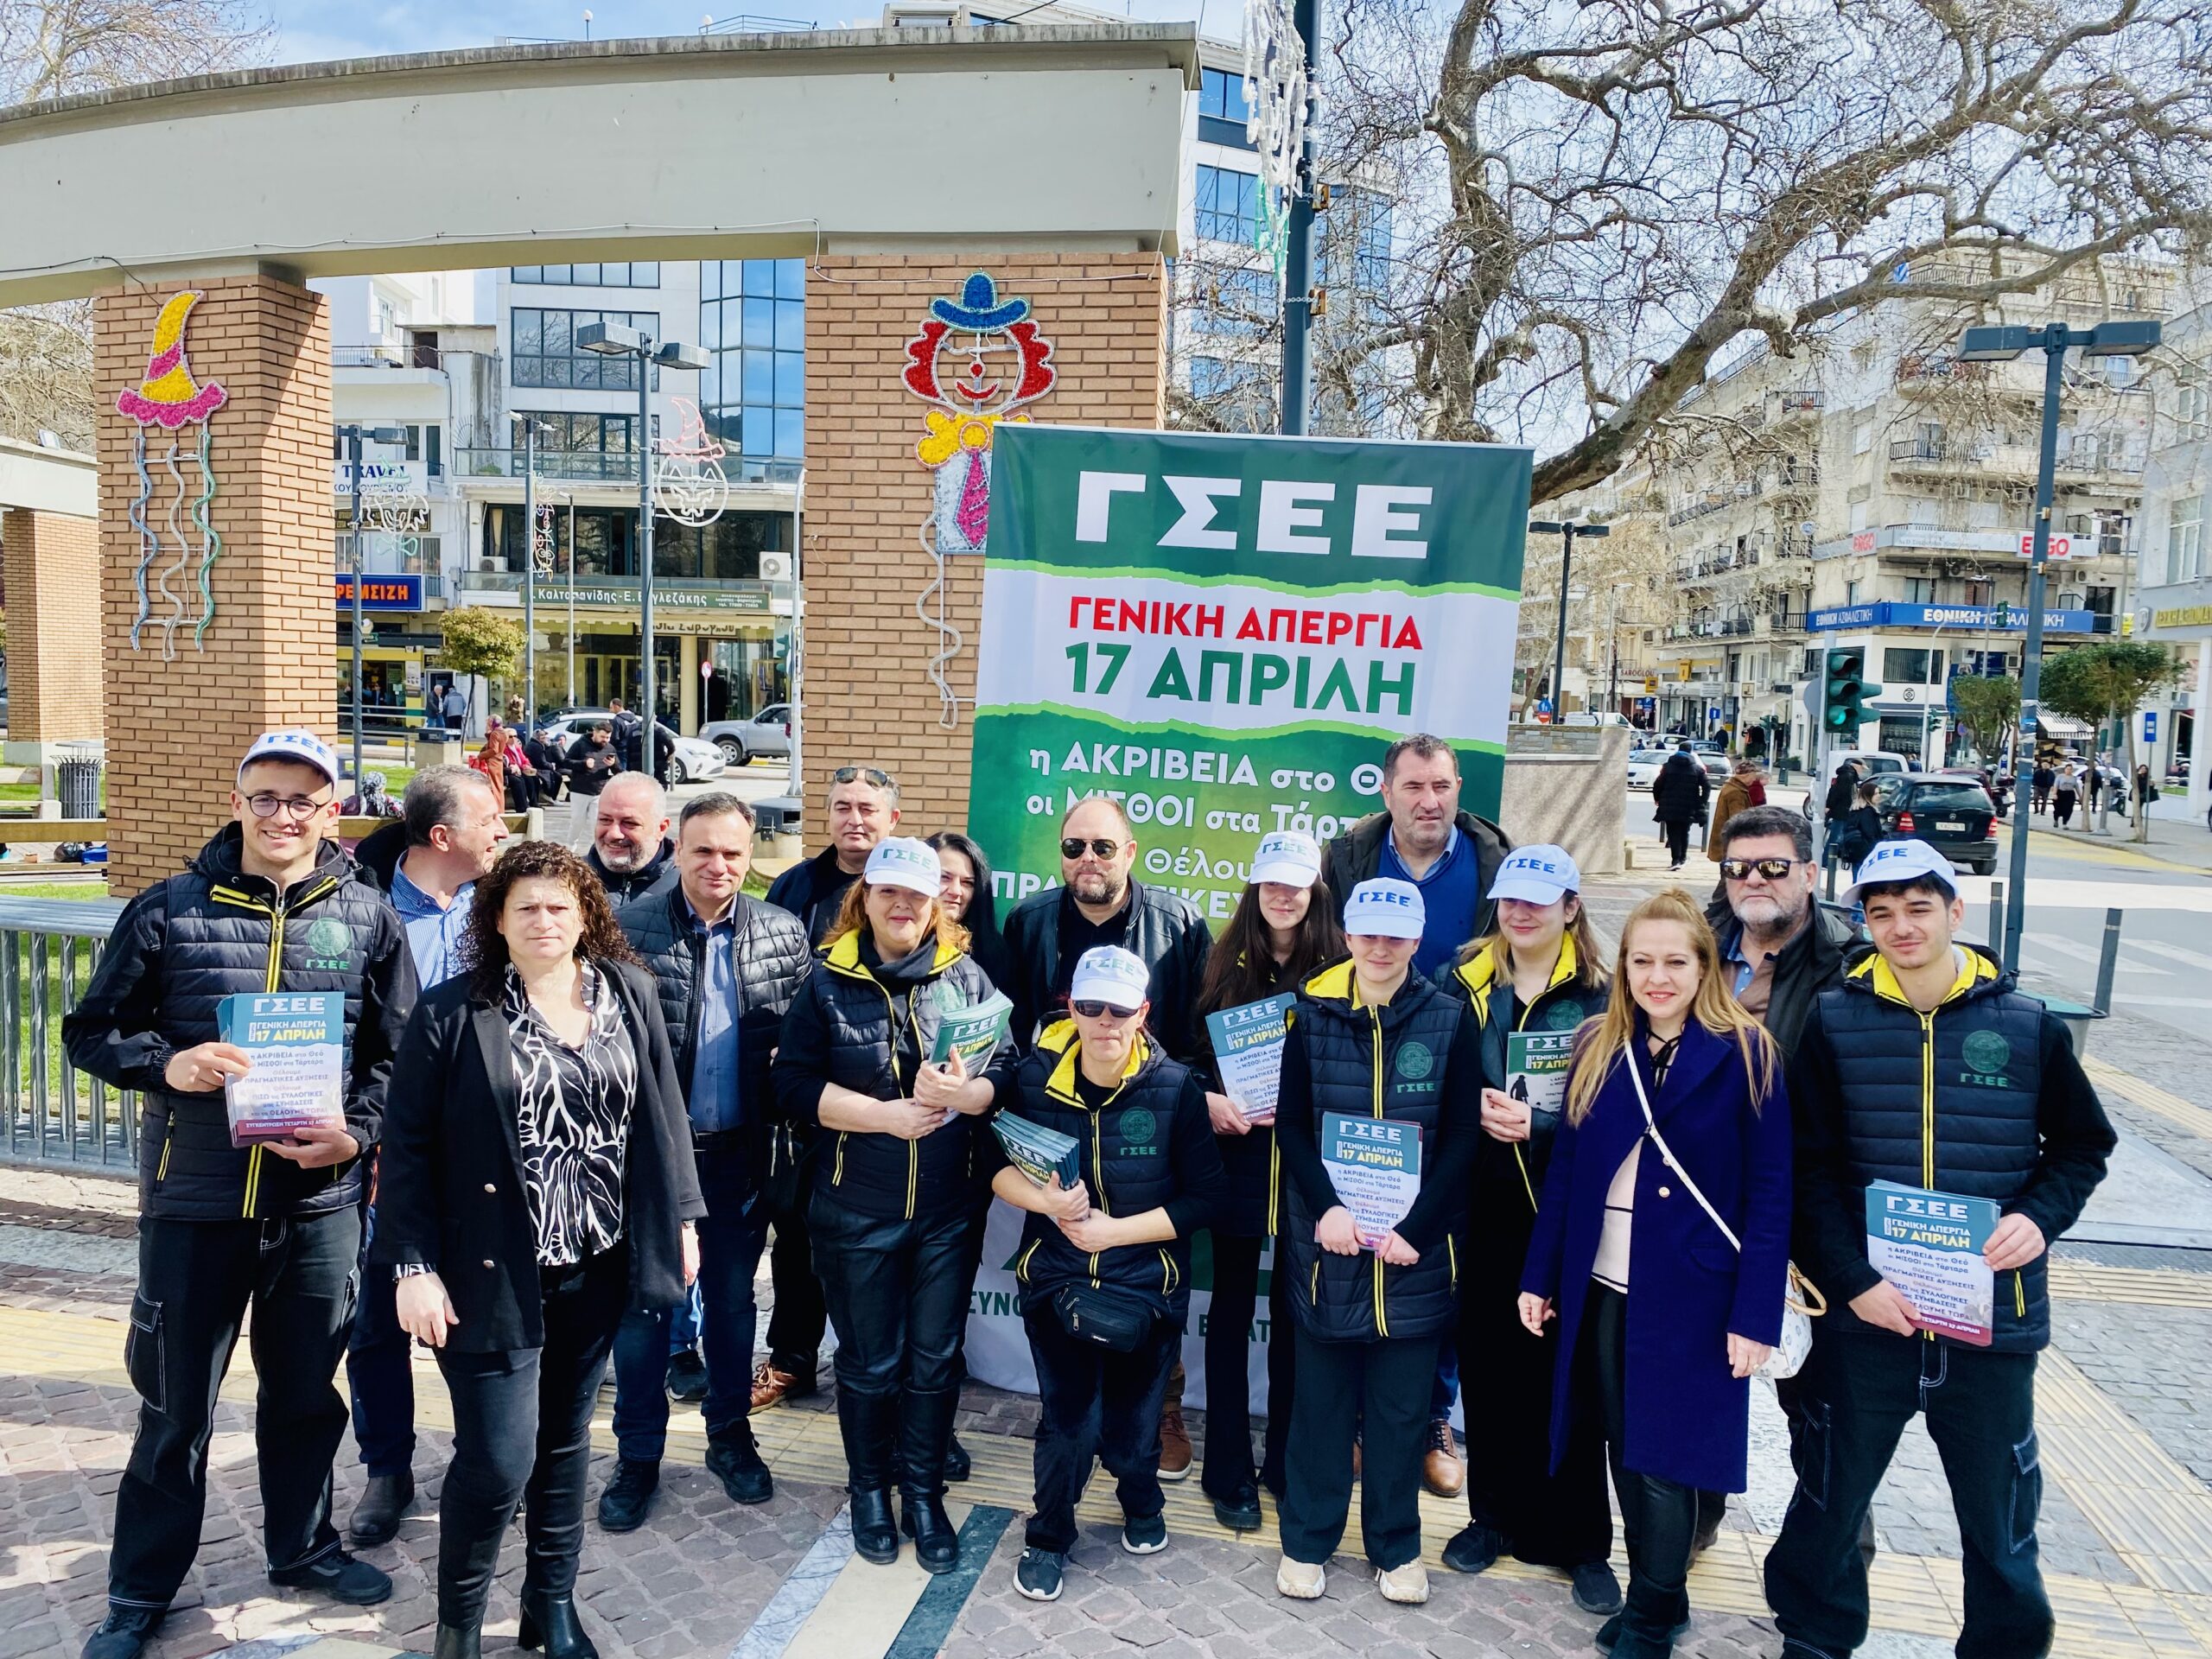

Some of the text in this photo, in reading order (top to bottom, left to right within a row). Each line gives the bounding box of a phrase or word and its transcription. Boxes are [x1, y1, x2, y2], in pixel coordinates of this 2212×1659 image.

[1076, 471, 1433, 559] ΓΣΕΕ
[1853, 532, 1875, 552] ERGO
[2022, 536, 2070, 556] EGO
[1070, 596, 1423, 650] ΓΕΝΙΚΗ ΑΠΕΡΓΙΑ
[1816, 613, 1837, 626] ΕΘΝΙΚΗ
[1923, 608, 1981, 624] ΕΘΝΙΚΗ
[1065, 642, 1416, 716] 17 ΑΠΡΙΛΗ
[1620, 669, 1655, 678] SAROGLOU
[268, 735, 327, 758] ΓΣΕΕ
[1029, 749, 1051, 775] η
[1061, 741, 1259, 787] ΑΚΡΙΒΕΙΑ
[1270, 768, 1335, 792] στο
[1027, 795, 1054, 816] οι
[1205, 810, 1261, 834] στα
[1262, 842, 1308, 855] ΓΣΕΕ
[882, 849, 932, 868] ΓΣΕΕ
[1506, 858, 1556, 874] ΓΣΕΕ
[1359, 892, 1412, 907] ΓΣΕΕ
[306, 959, 350, 969] ΓΣΕΕ
[1085, 959, 1137, 975] ΓΣΕΕ
[254, 997, 325, 1012] ΓΣΕΕ
[1223, 1001, 1279, 1027] ΓΣΕΕ
[953, 1013, 1001, 1037] ΓΣΕΕ
[1231, 1027, 1255, 1039] ΓΕΝΙΚΗ
[257, 1030, 270, 1041] 17
[273, 1029, 325, 1040] ΑΠΡΙΛΗ
[1234, 1038, 1243, 1048] 17
[1248, 1026, 1286, 1045] ΑΠΡΙΛΗ
[1961, 1073, 2009, 1088] ΓΣΕΕ
[1396, 1084, 1435, 1094] ΓΣΕΕ
[1340, 1121, 1402, 1141] ΓΣΕΕ
[1120, 1147, 1157, 1155] ΓΣΕΕ
[1343, 1141, 1370, 1151] ΓΕΝΙΚΗ
[1371, 1146, 1403, 1156] ΑΠΕΡΓΙΑ
[1344, 1150, 1402, 1167] 17 ΑΠΡΙΛΗ
[1344, 1170, 1373, 1179] ΑΚΡΙΒΕΙΑ
[1886, 1195, 1967, 1219] ΓΣΕΕ
[1891, 1218, 1927, 1230] ΓΕΝΙΚΗ
[1929, 1224, 1970, 1236] ΑΠΕΡΓΙΑ
[1892, 1227, 1970, 1249] 17 ΑΠΡΙΛΗ
[1895, 1248, 1933, 1260] ΑΚΡΙΒΕΙΑ
[1883, 1266, 1934, 1281] ΠΡΑΓΜΑΤΙΚΕΣ
[1921, 1289, 1968, 1304] ΣΥΛΛΟΓΙΚΕΣ
[1910, 1302, 1948, 1314] ΕΛΟΥΜΕ
